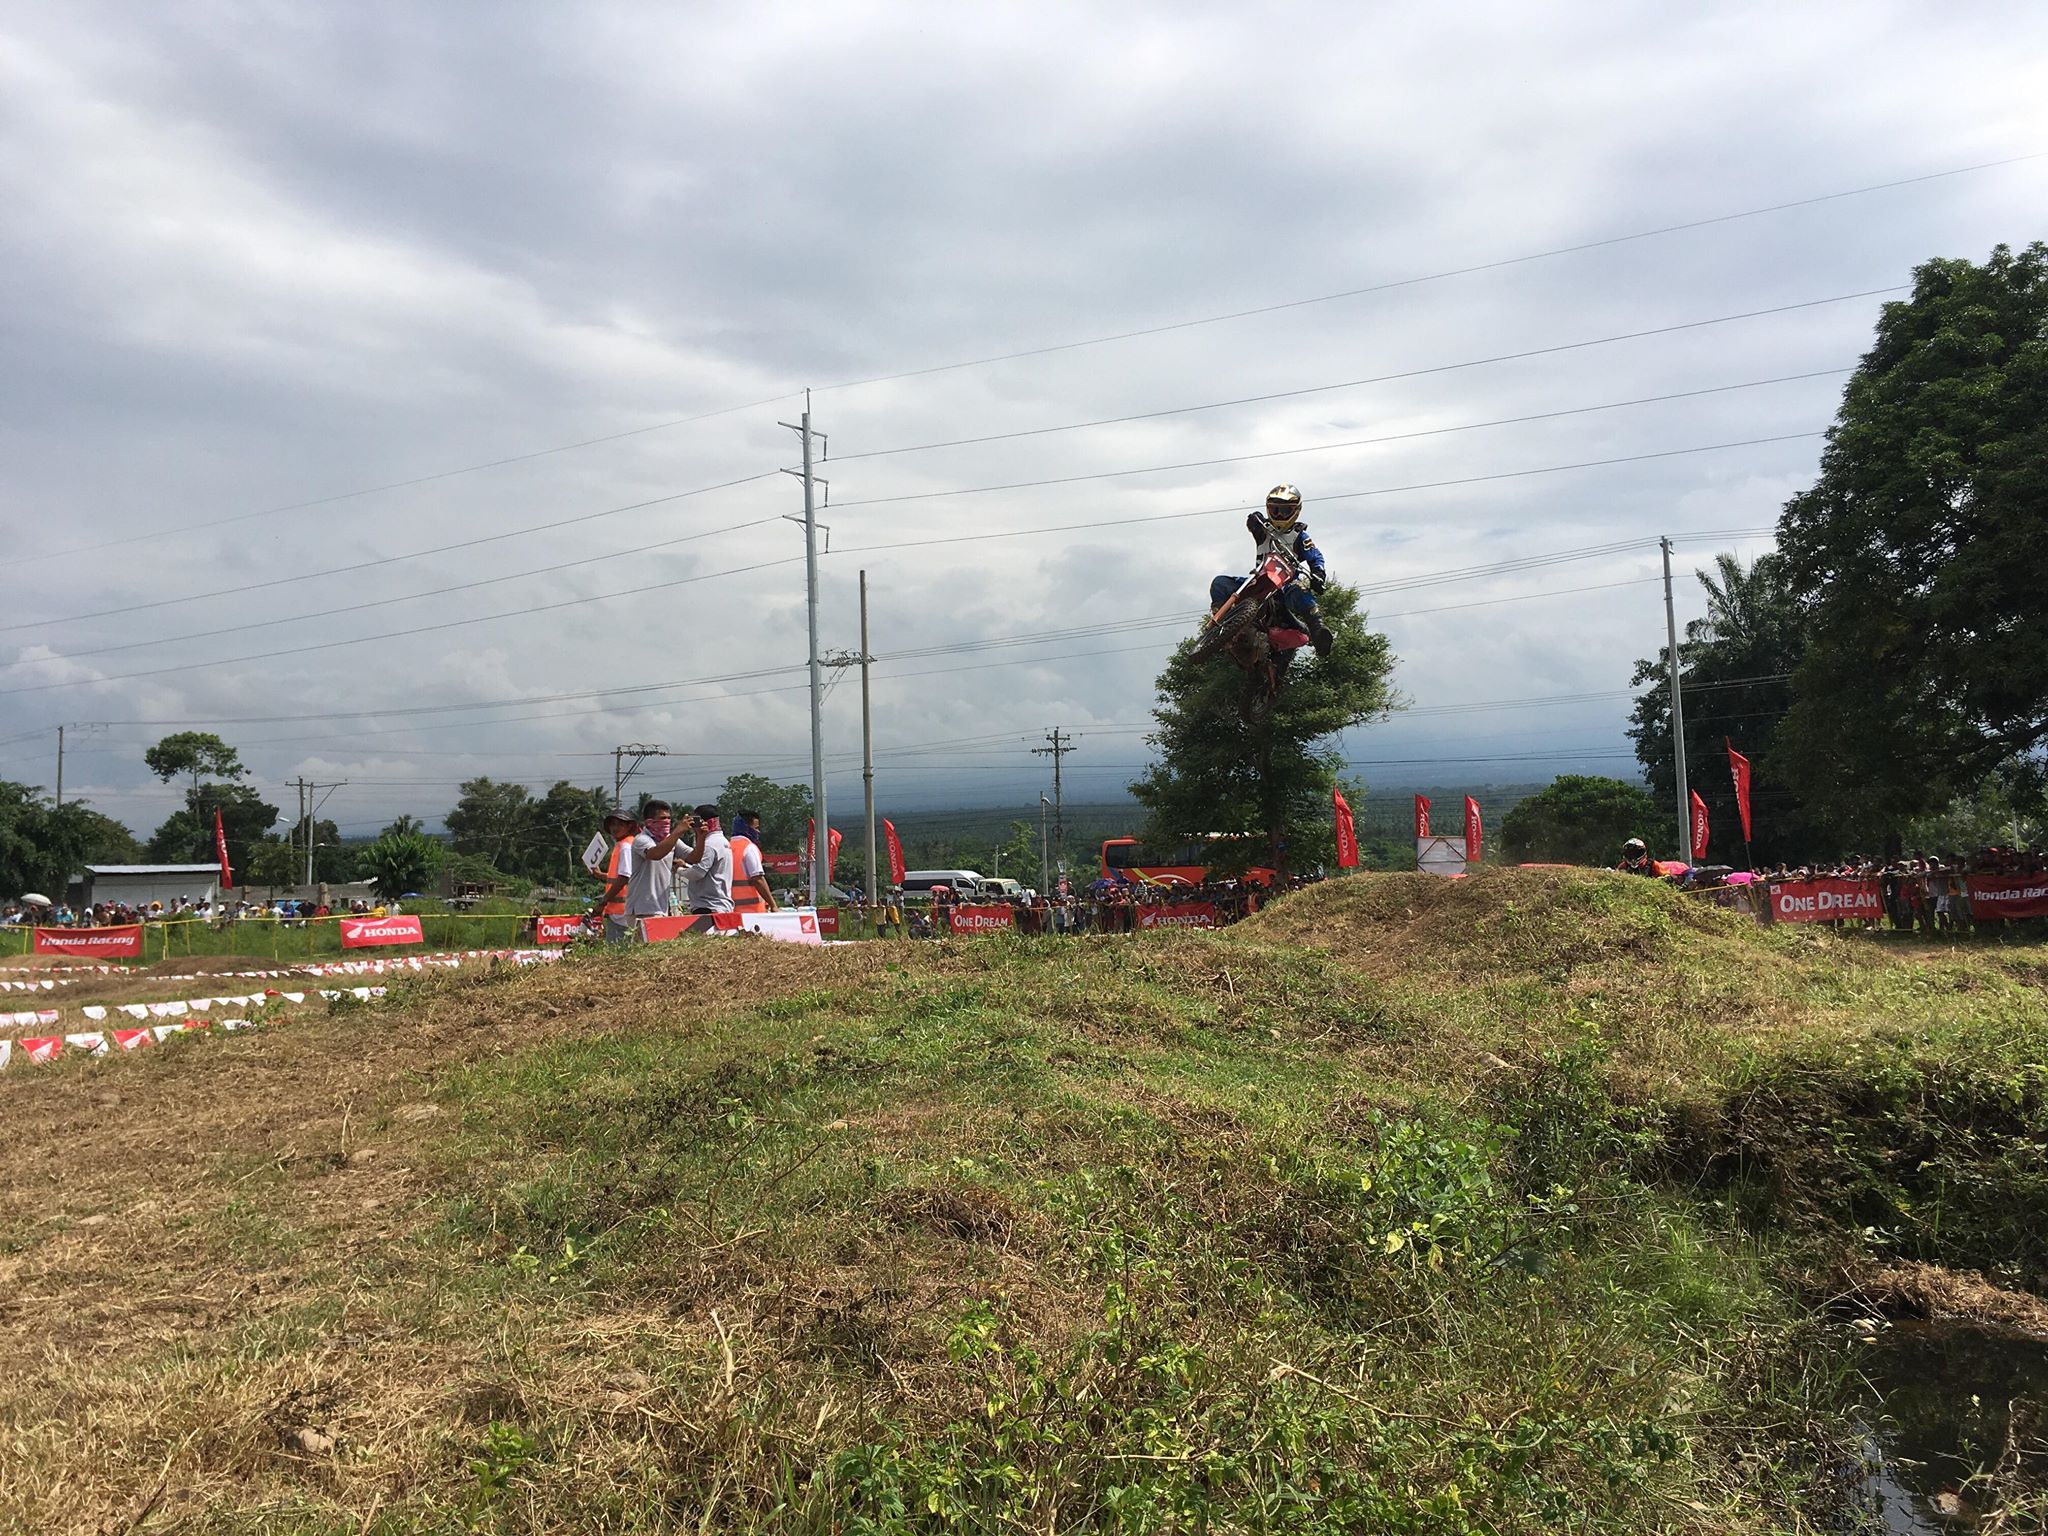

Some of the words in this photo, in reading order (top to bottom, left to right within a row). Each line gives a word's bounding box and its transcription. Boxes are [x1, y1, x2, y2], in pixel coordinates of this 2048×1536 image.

[1974, 889, 2020, 901] Honda
[2023, 887, 2048, 898] Rac
[1780, 894, 1815, 913] ONE
[1818, 891, 1878, 910] DREAM
[954, 915, 974, 927] ONE
[975, 914, 1009, 928] DREAM
[1156, 914, 1212, 925] HONDA
[364, 926, 419, 938] HONDA
[541, 925, 562, 937] ONE
[41, 937, 86, 946] Honda
[87, 936, 135, 946] Racing
